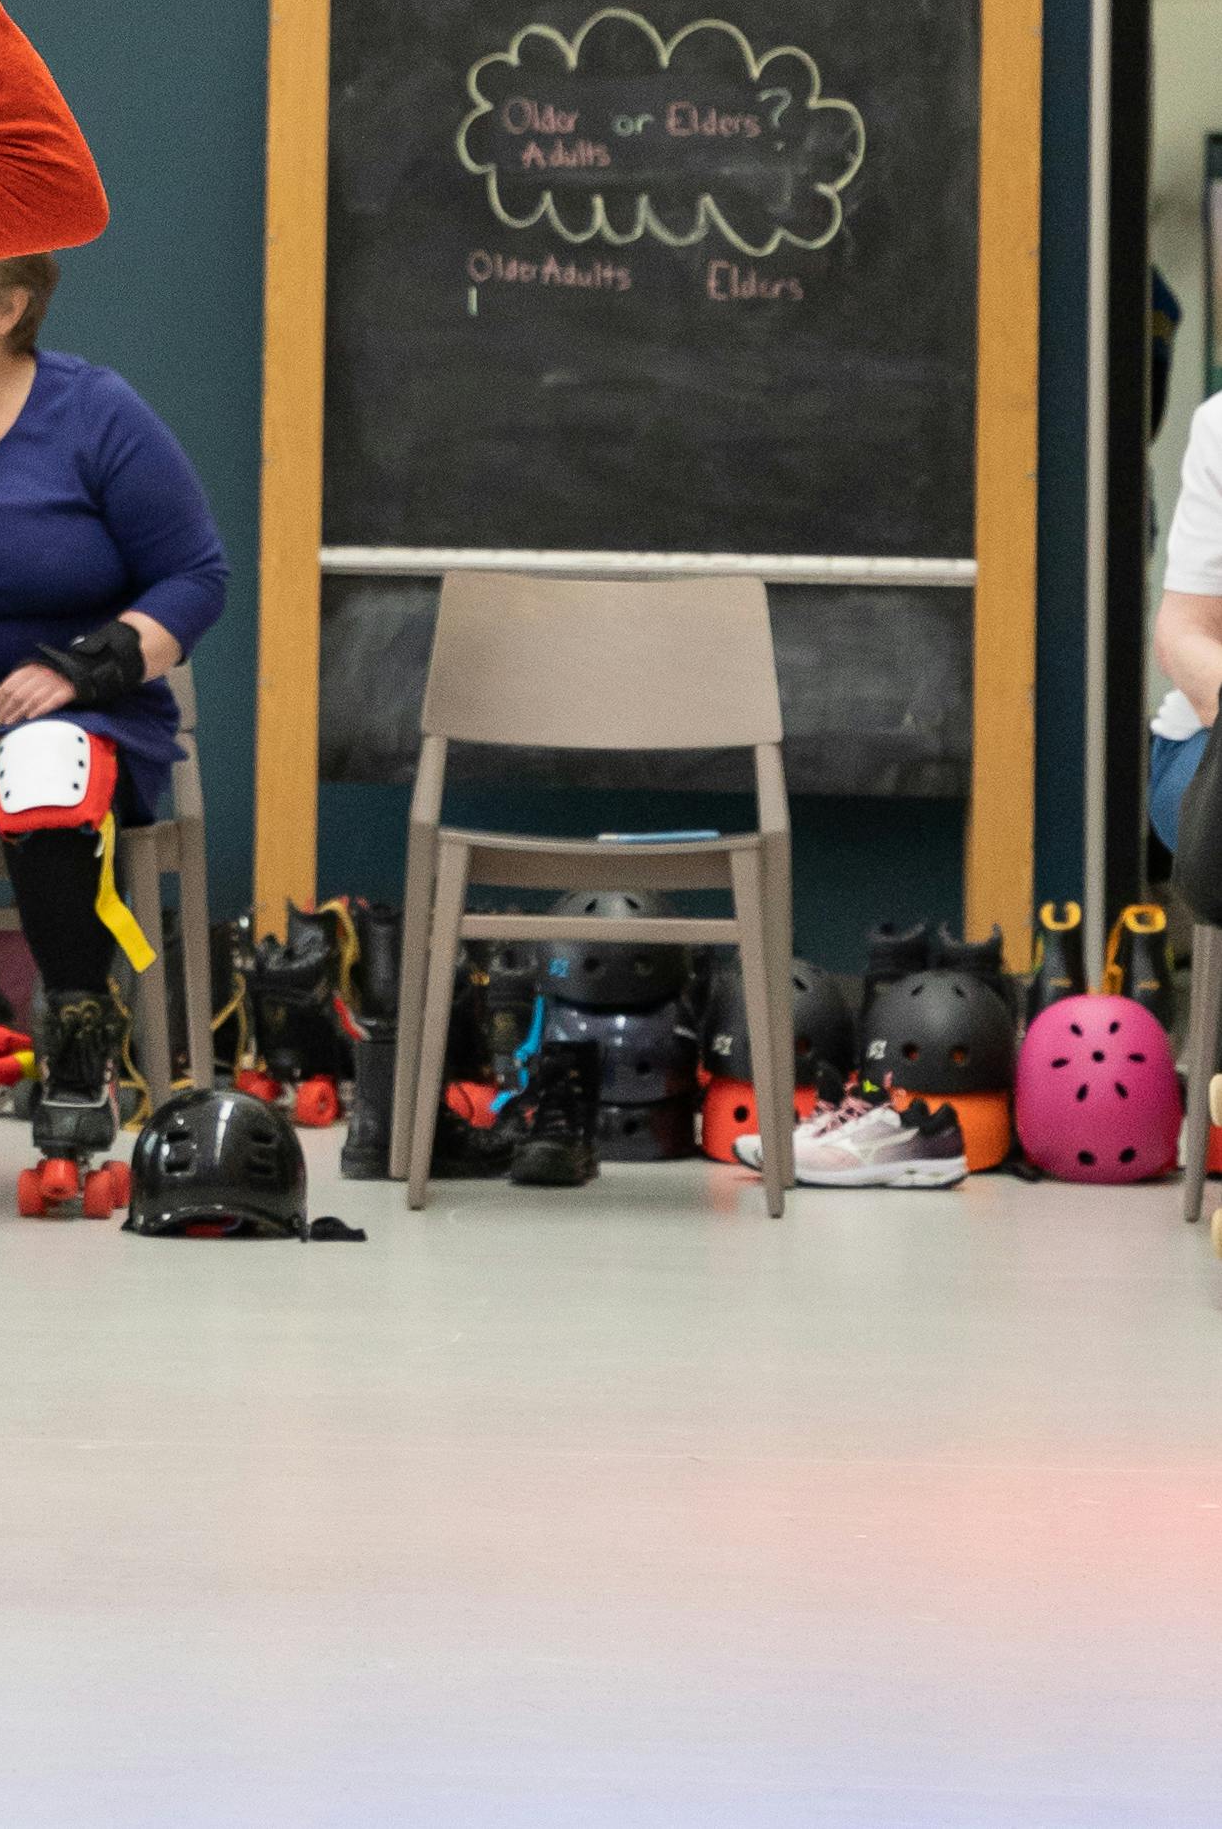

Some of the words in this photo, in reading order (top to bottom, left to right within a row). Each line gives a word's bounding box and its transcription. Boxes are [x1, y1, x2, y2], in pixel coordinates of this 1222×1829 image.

[502, 97, 578, 135] Older
[611, 112, 655, 137] or
[520, 139, 611, 169] Adults
[706, 259, 804, 300] Elders
